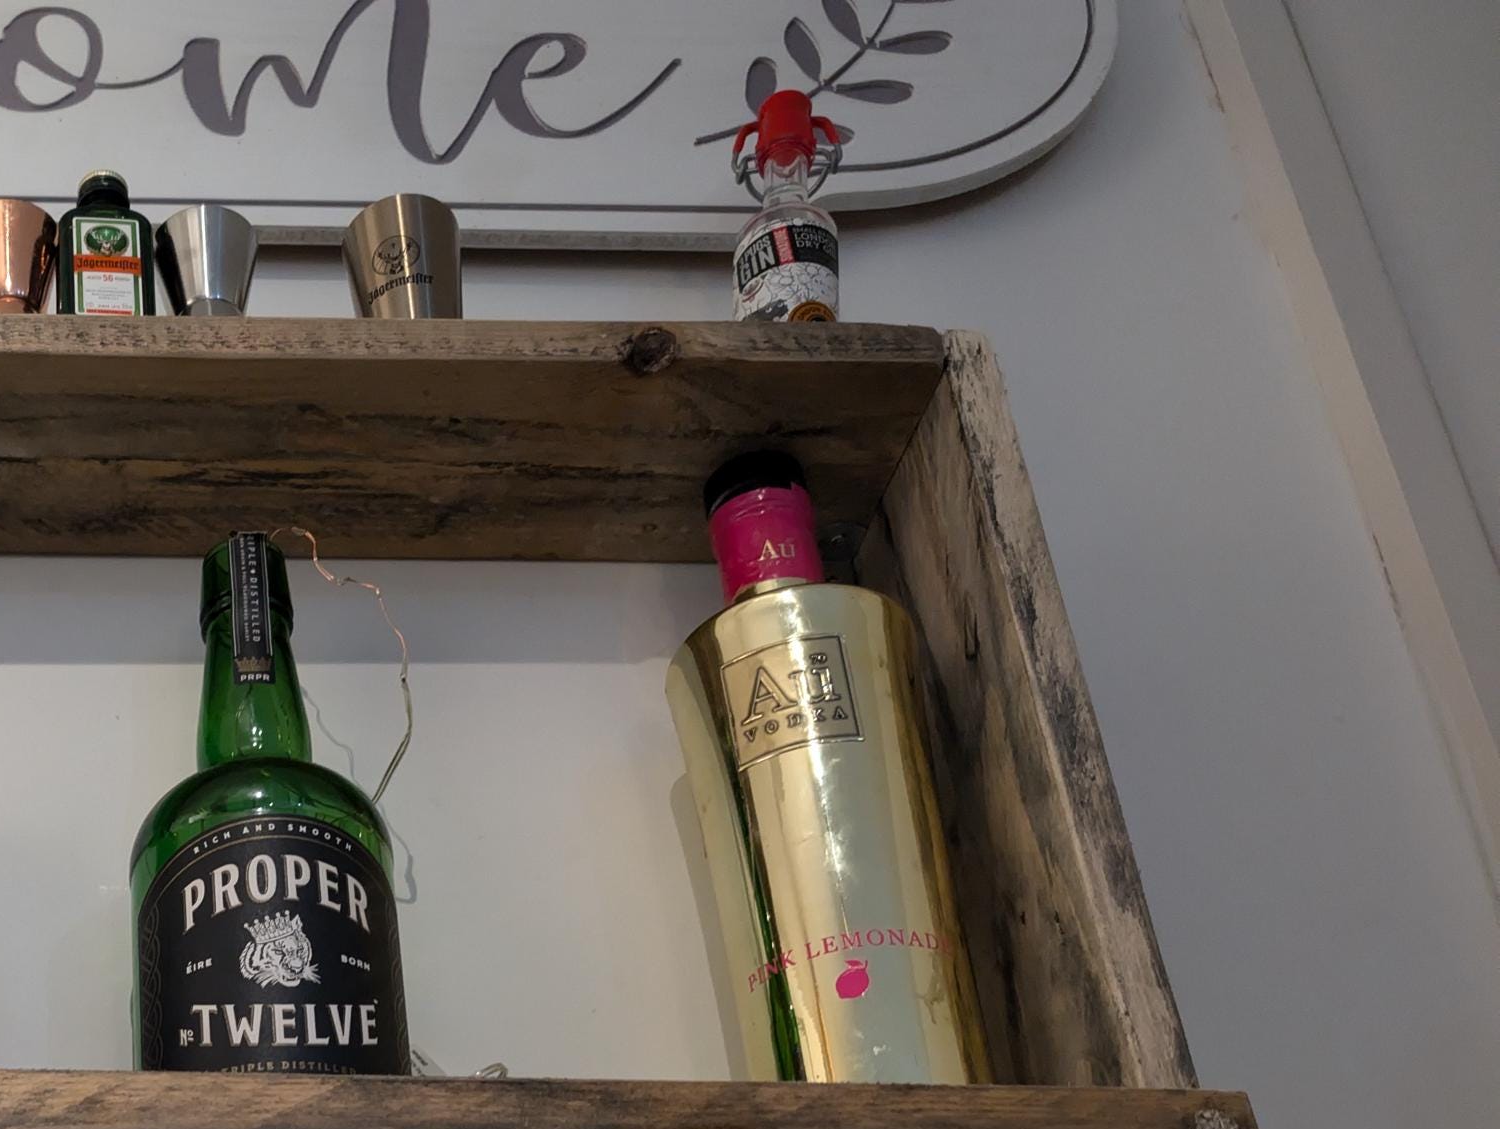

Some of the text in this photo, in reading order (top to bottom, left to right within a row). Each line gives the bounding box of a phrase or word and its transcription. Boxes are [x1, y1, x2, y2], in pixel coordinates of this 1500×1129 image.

[744, 235, 772, 259] PUGS
[796, 241, 820, 250] DRY
[739, 245, 776, 286] GIN
[759, 538, 796, 562] Au
[249, 577, 261, 643] DISTILLED
[240, 672, 270, 682] PRPR
[741, 665, 841, 726] Au
[743, 705, 848, 743] VODKA
[193, 823, 352, 855] RICH AND SMOOTH
[183, 854, 371, 935] PROPER
[340, 954, 371, 972] BORN
[747, 949, 797, 993] PINK
[190, 1003, 379, 1047] TWELVE
